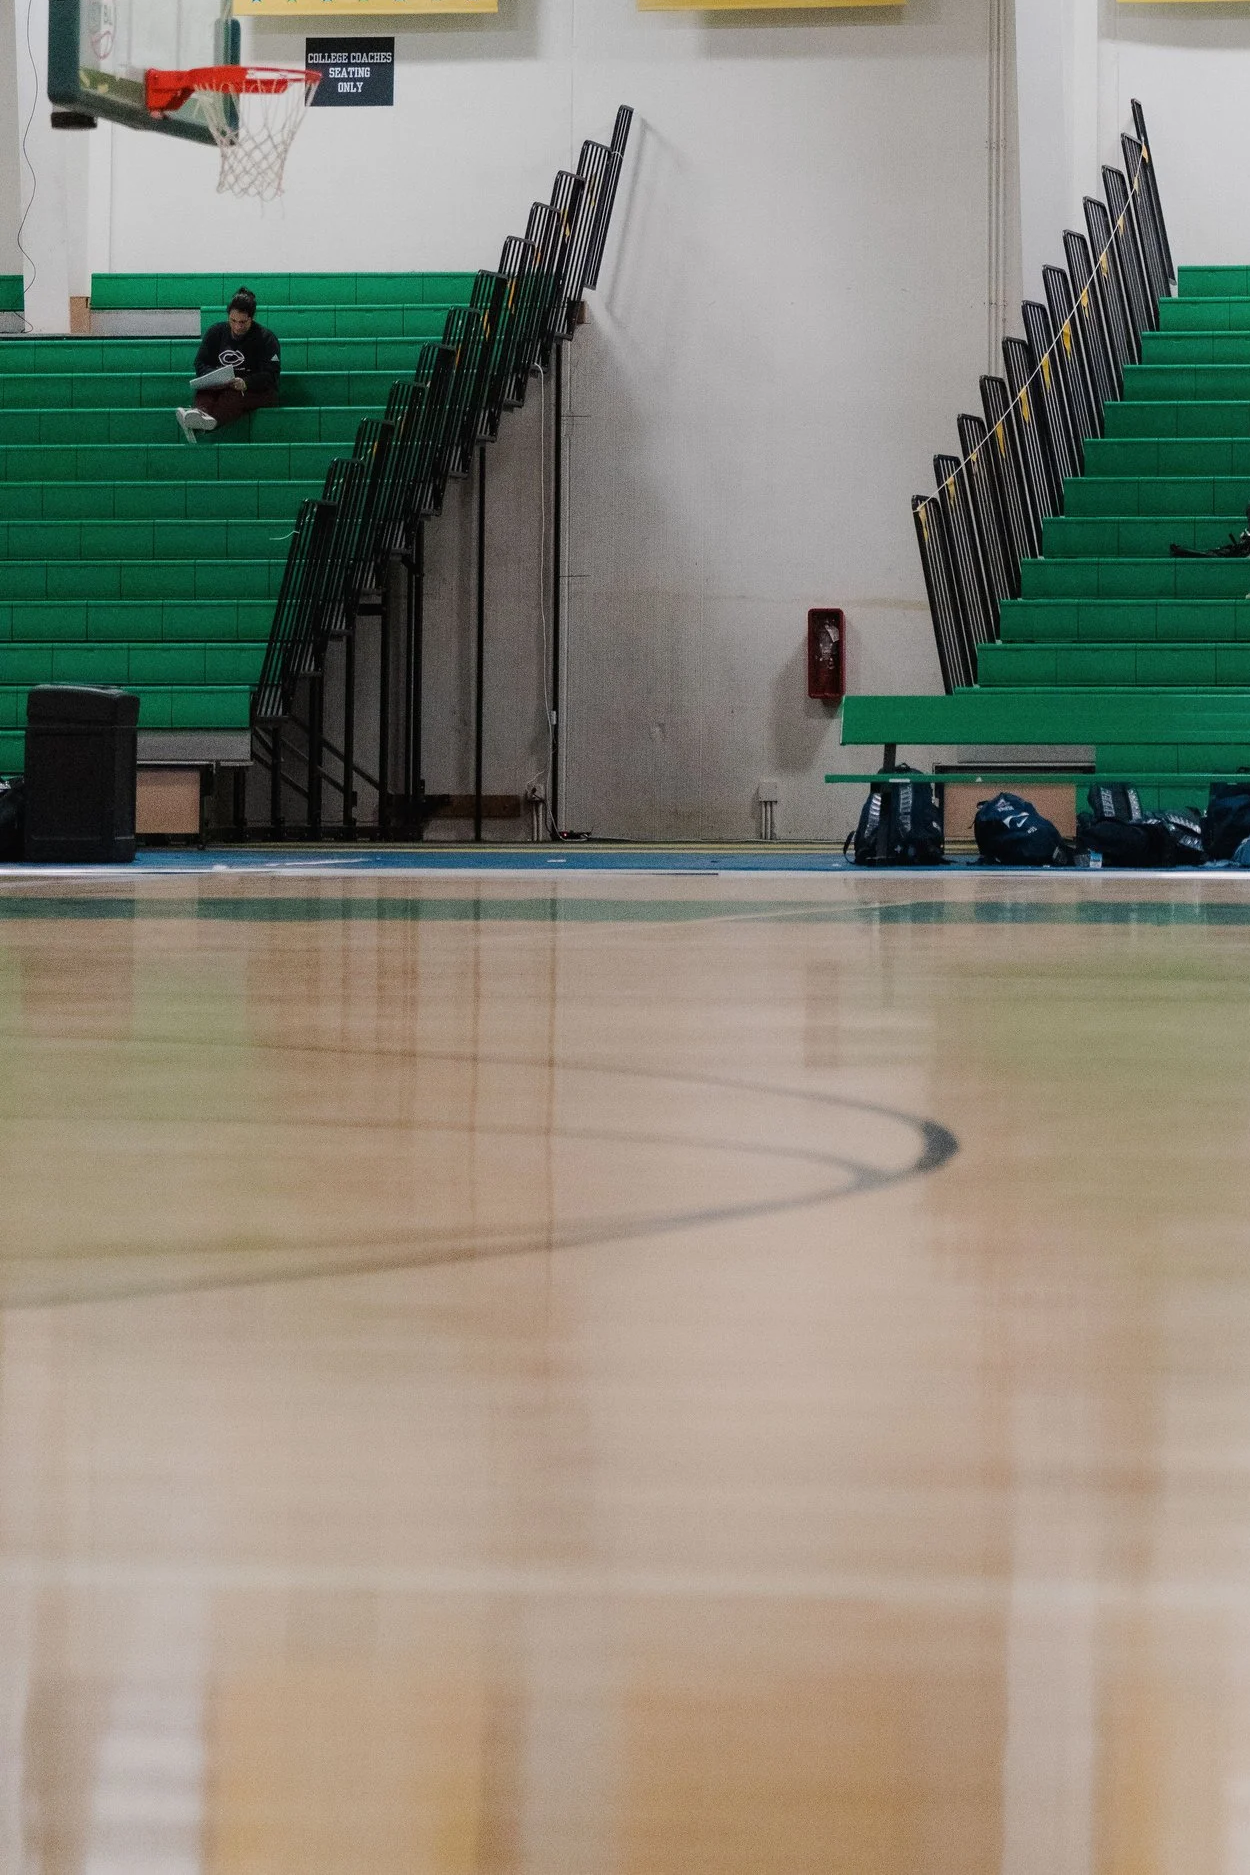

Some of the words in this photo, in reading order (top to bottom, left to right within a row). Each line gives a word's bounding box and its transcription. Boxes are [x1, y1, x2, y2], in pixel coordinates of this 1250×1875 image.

[308, 53, 348, 64] COLLEGE
[350, 52, 392, 63] COACHES
[329, 67, 371, 78] SEATING
[337, 82, 364, 93] ONLY
